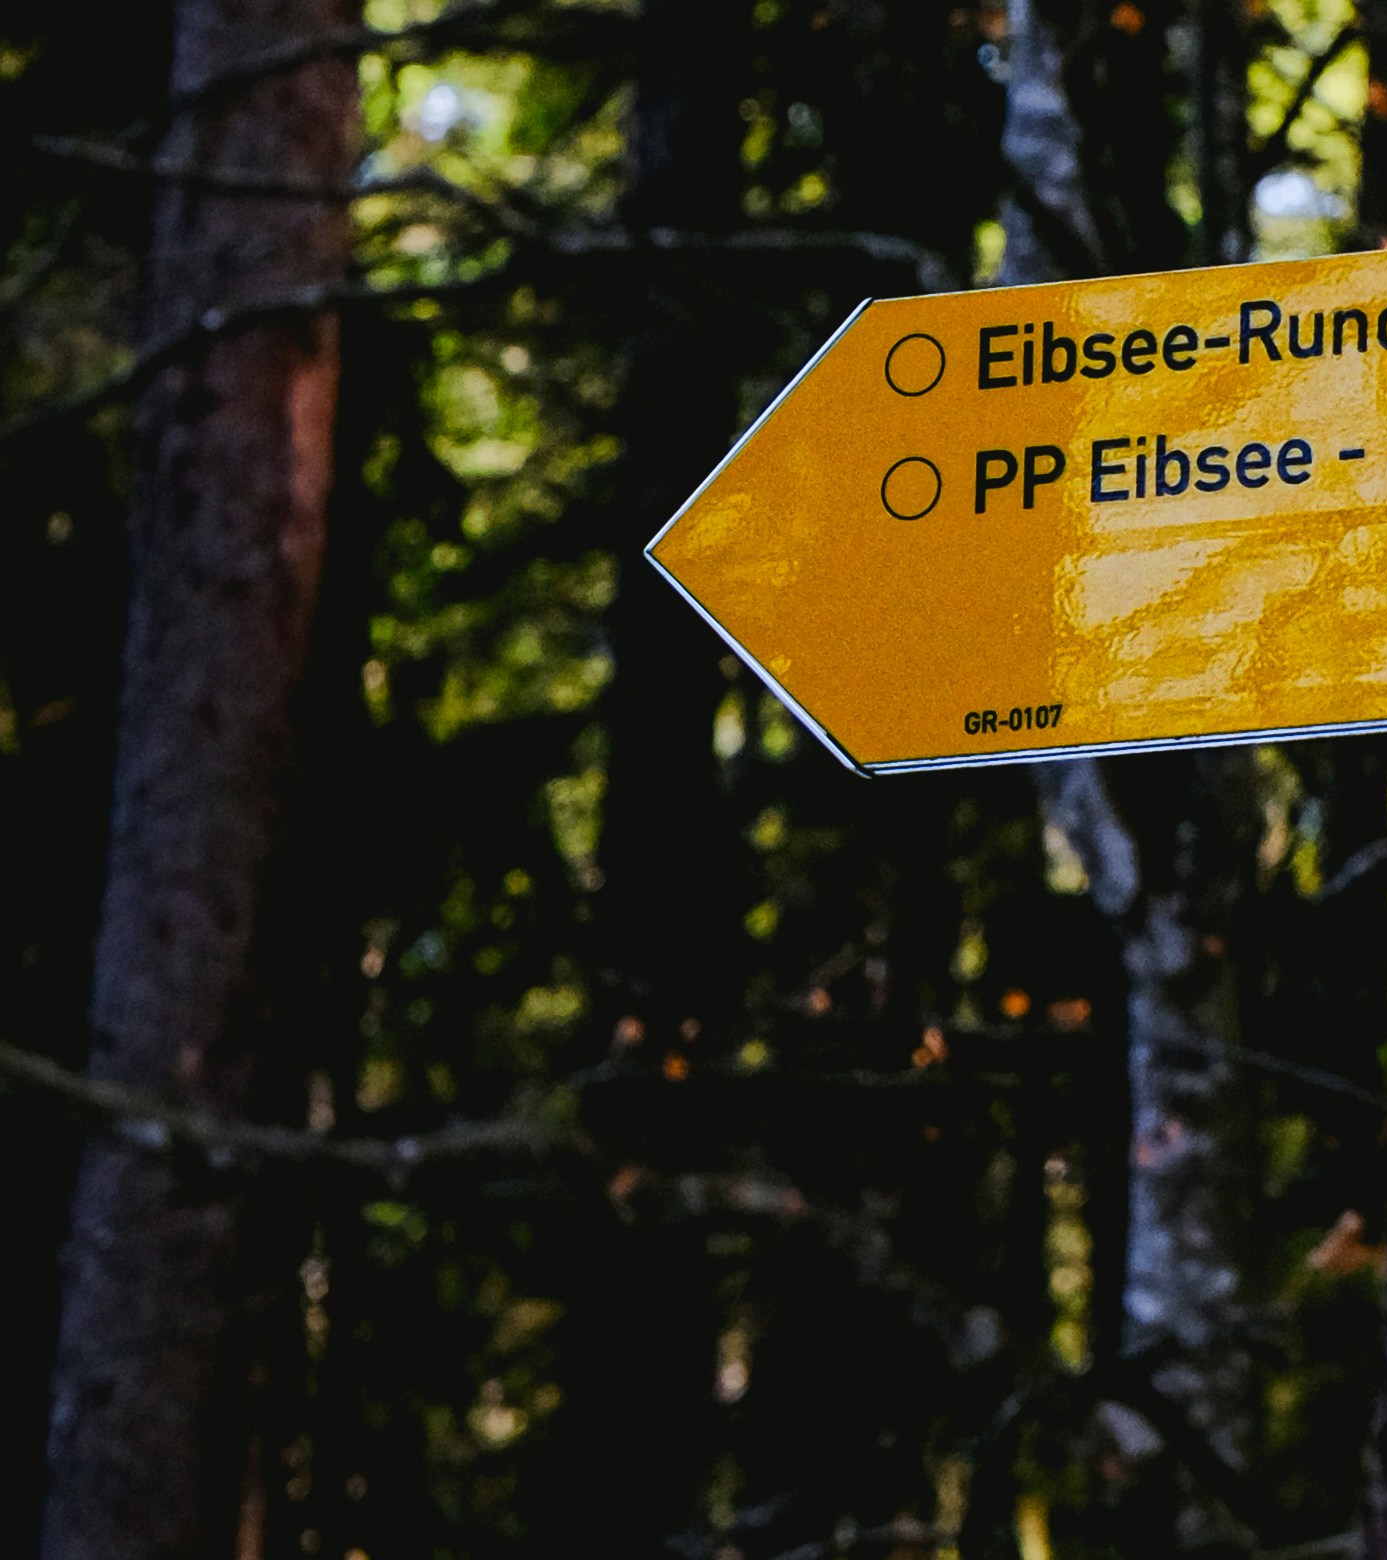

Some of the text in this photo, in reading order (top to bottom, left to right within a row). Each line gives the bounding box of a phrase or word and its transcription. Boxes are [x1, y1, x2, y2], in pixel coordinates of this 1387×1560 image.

[973, 443, 1067, 515] PP
[1090, 435, 1312, 504] Eibsee
[963, 703, 1064, 736] GR-0107
